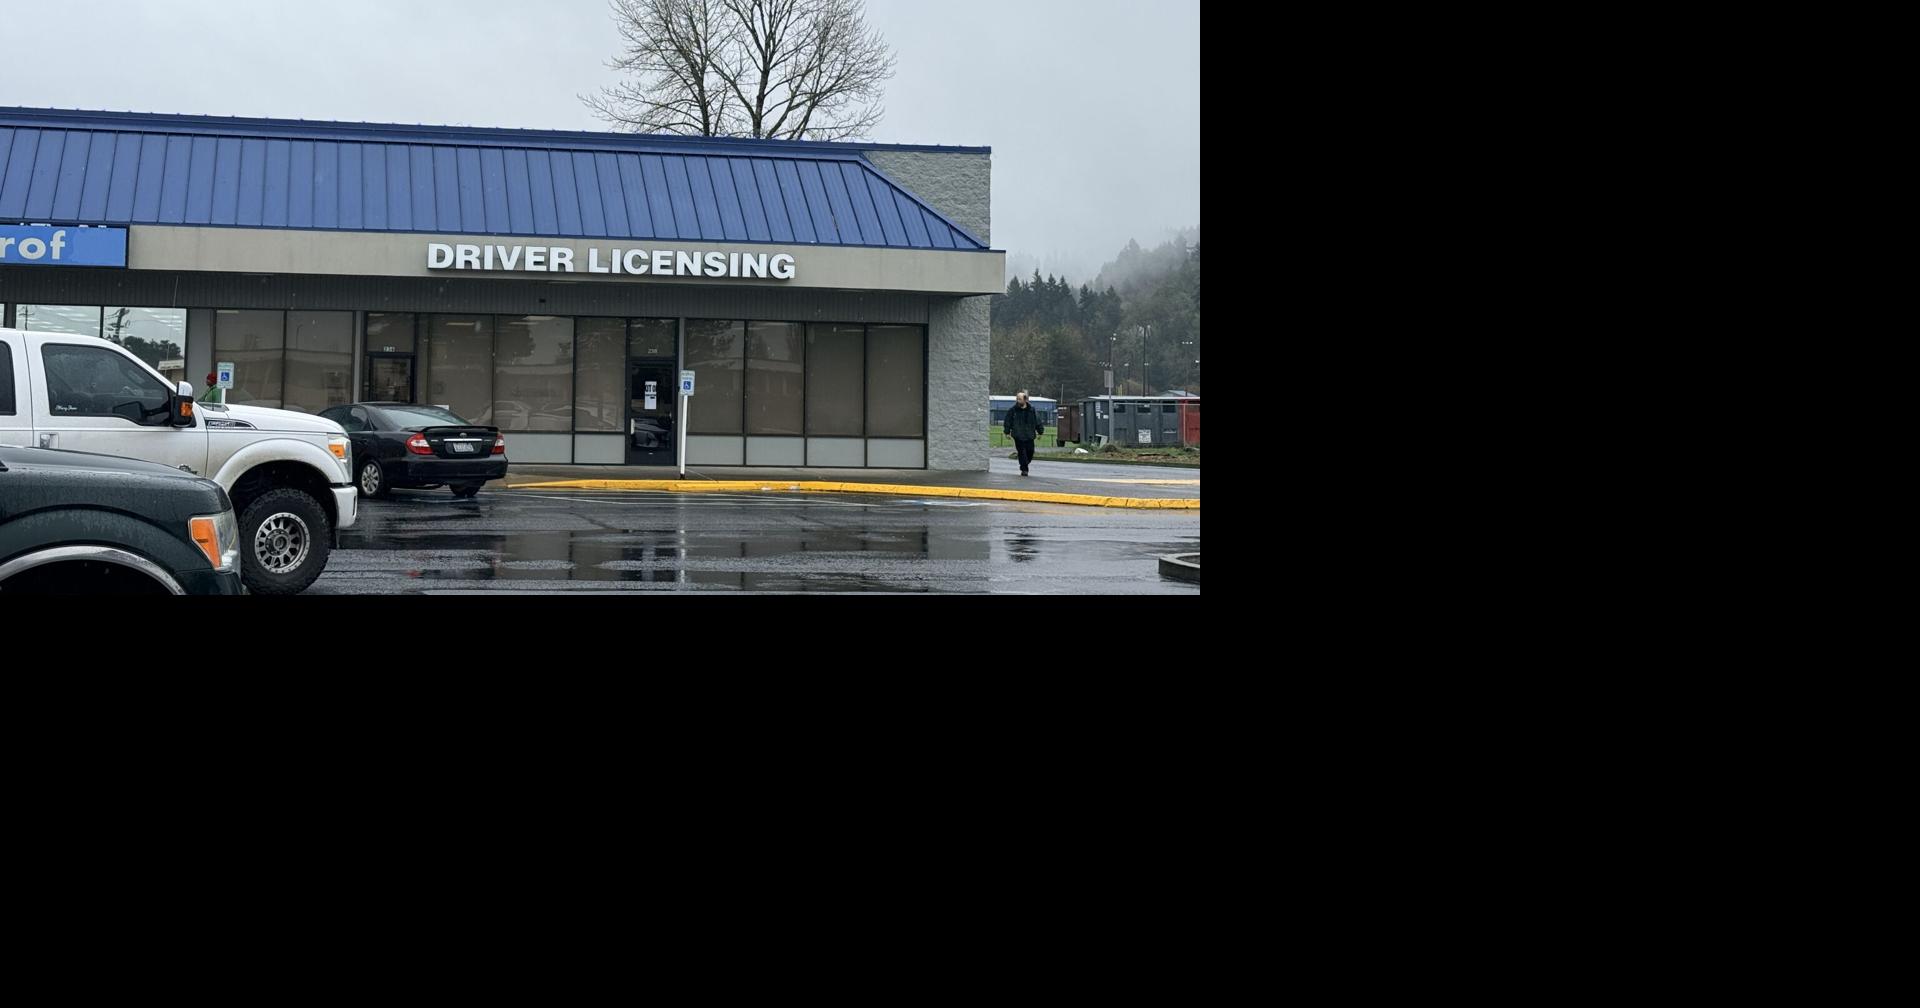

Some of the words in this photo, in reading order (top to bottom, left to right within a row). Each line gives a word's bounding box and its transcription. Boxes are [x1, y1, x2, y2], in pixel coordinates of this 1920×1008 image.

[0, 230, 66, 260] rof
[427, 243, 574, 272] DRIVER
[588, 248, 796, 279] LICENSING
